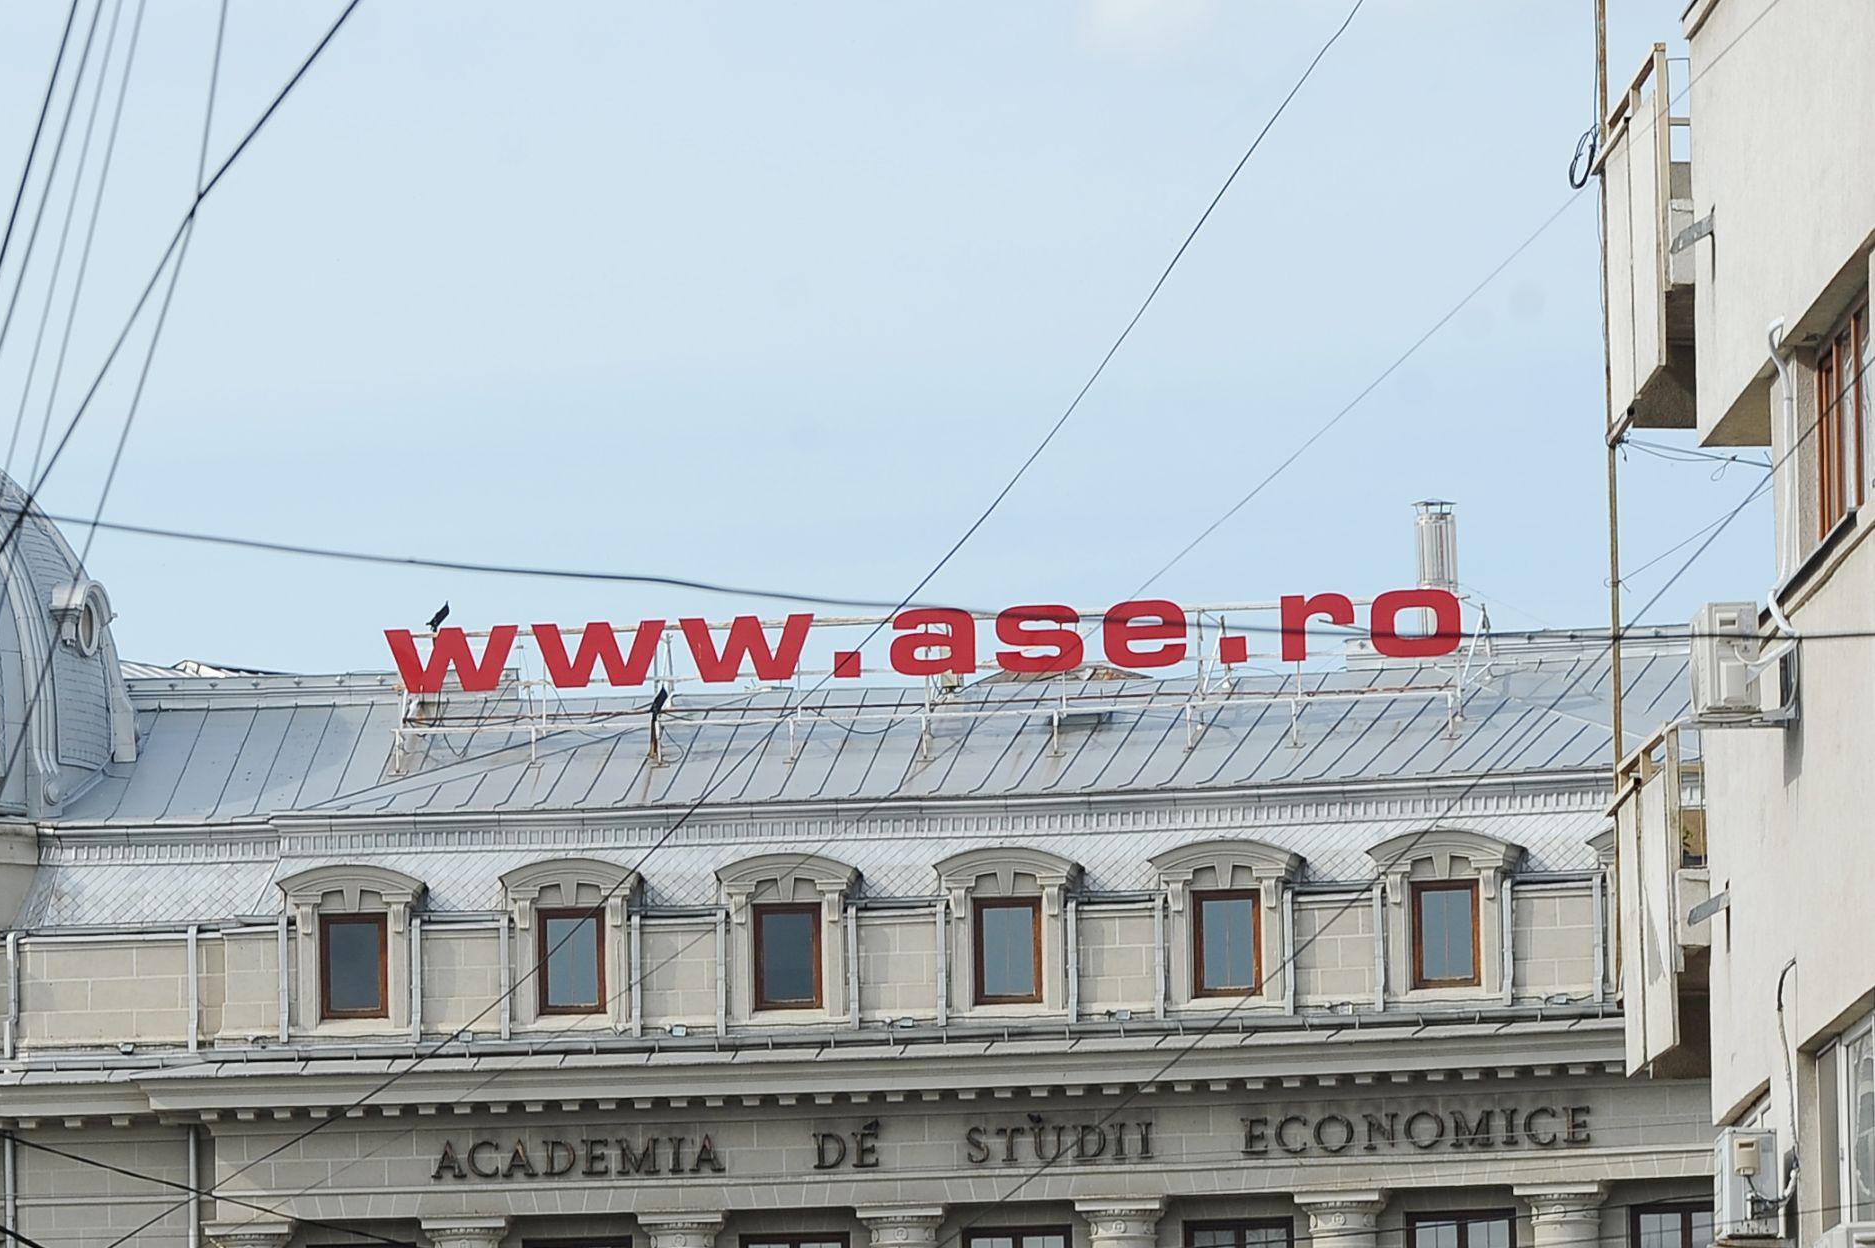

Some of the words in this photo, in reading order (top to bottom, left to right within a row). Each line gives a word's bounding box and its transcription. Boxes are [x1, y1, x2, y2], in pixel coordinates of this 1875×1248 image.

[384, 589, 1461, 693] www.ase.ro
[433, 1133, 726, 1179] ACADEMIA
[812, 1130, 879, 1169] DE
[966, 1121, 1154, 1163] STUDII
[1240, 1106, 1592, 1155] ECONOMICE
